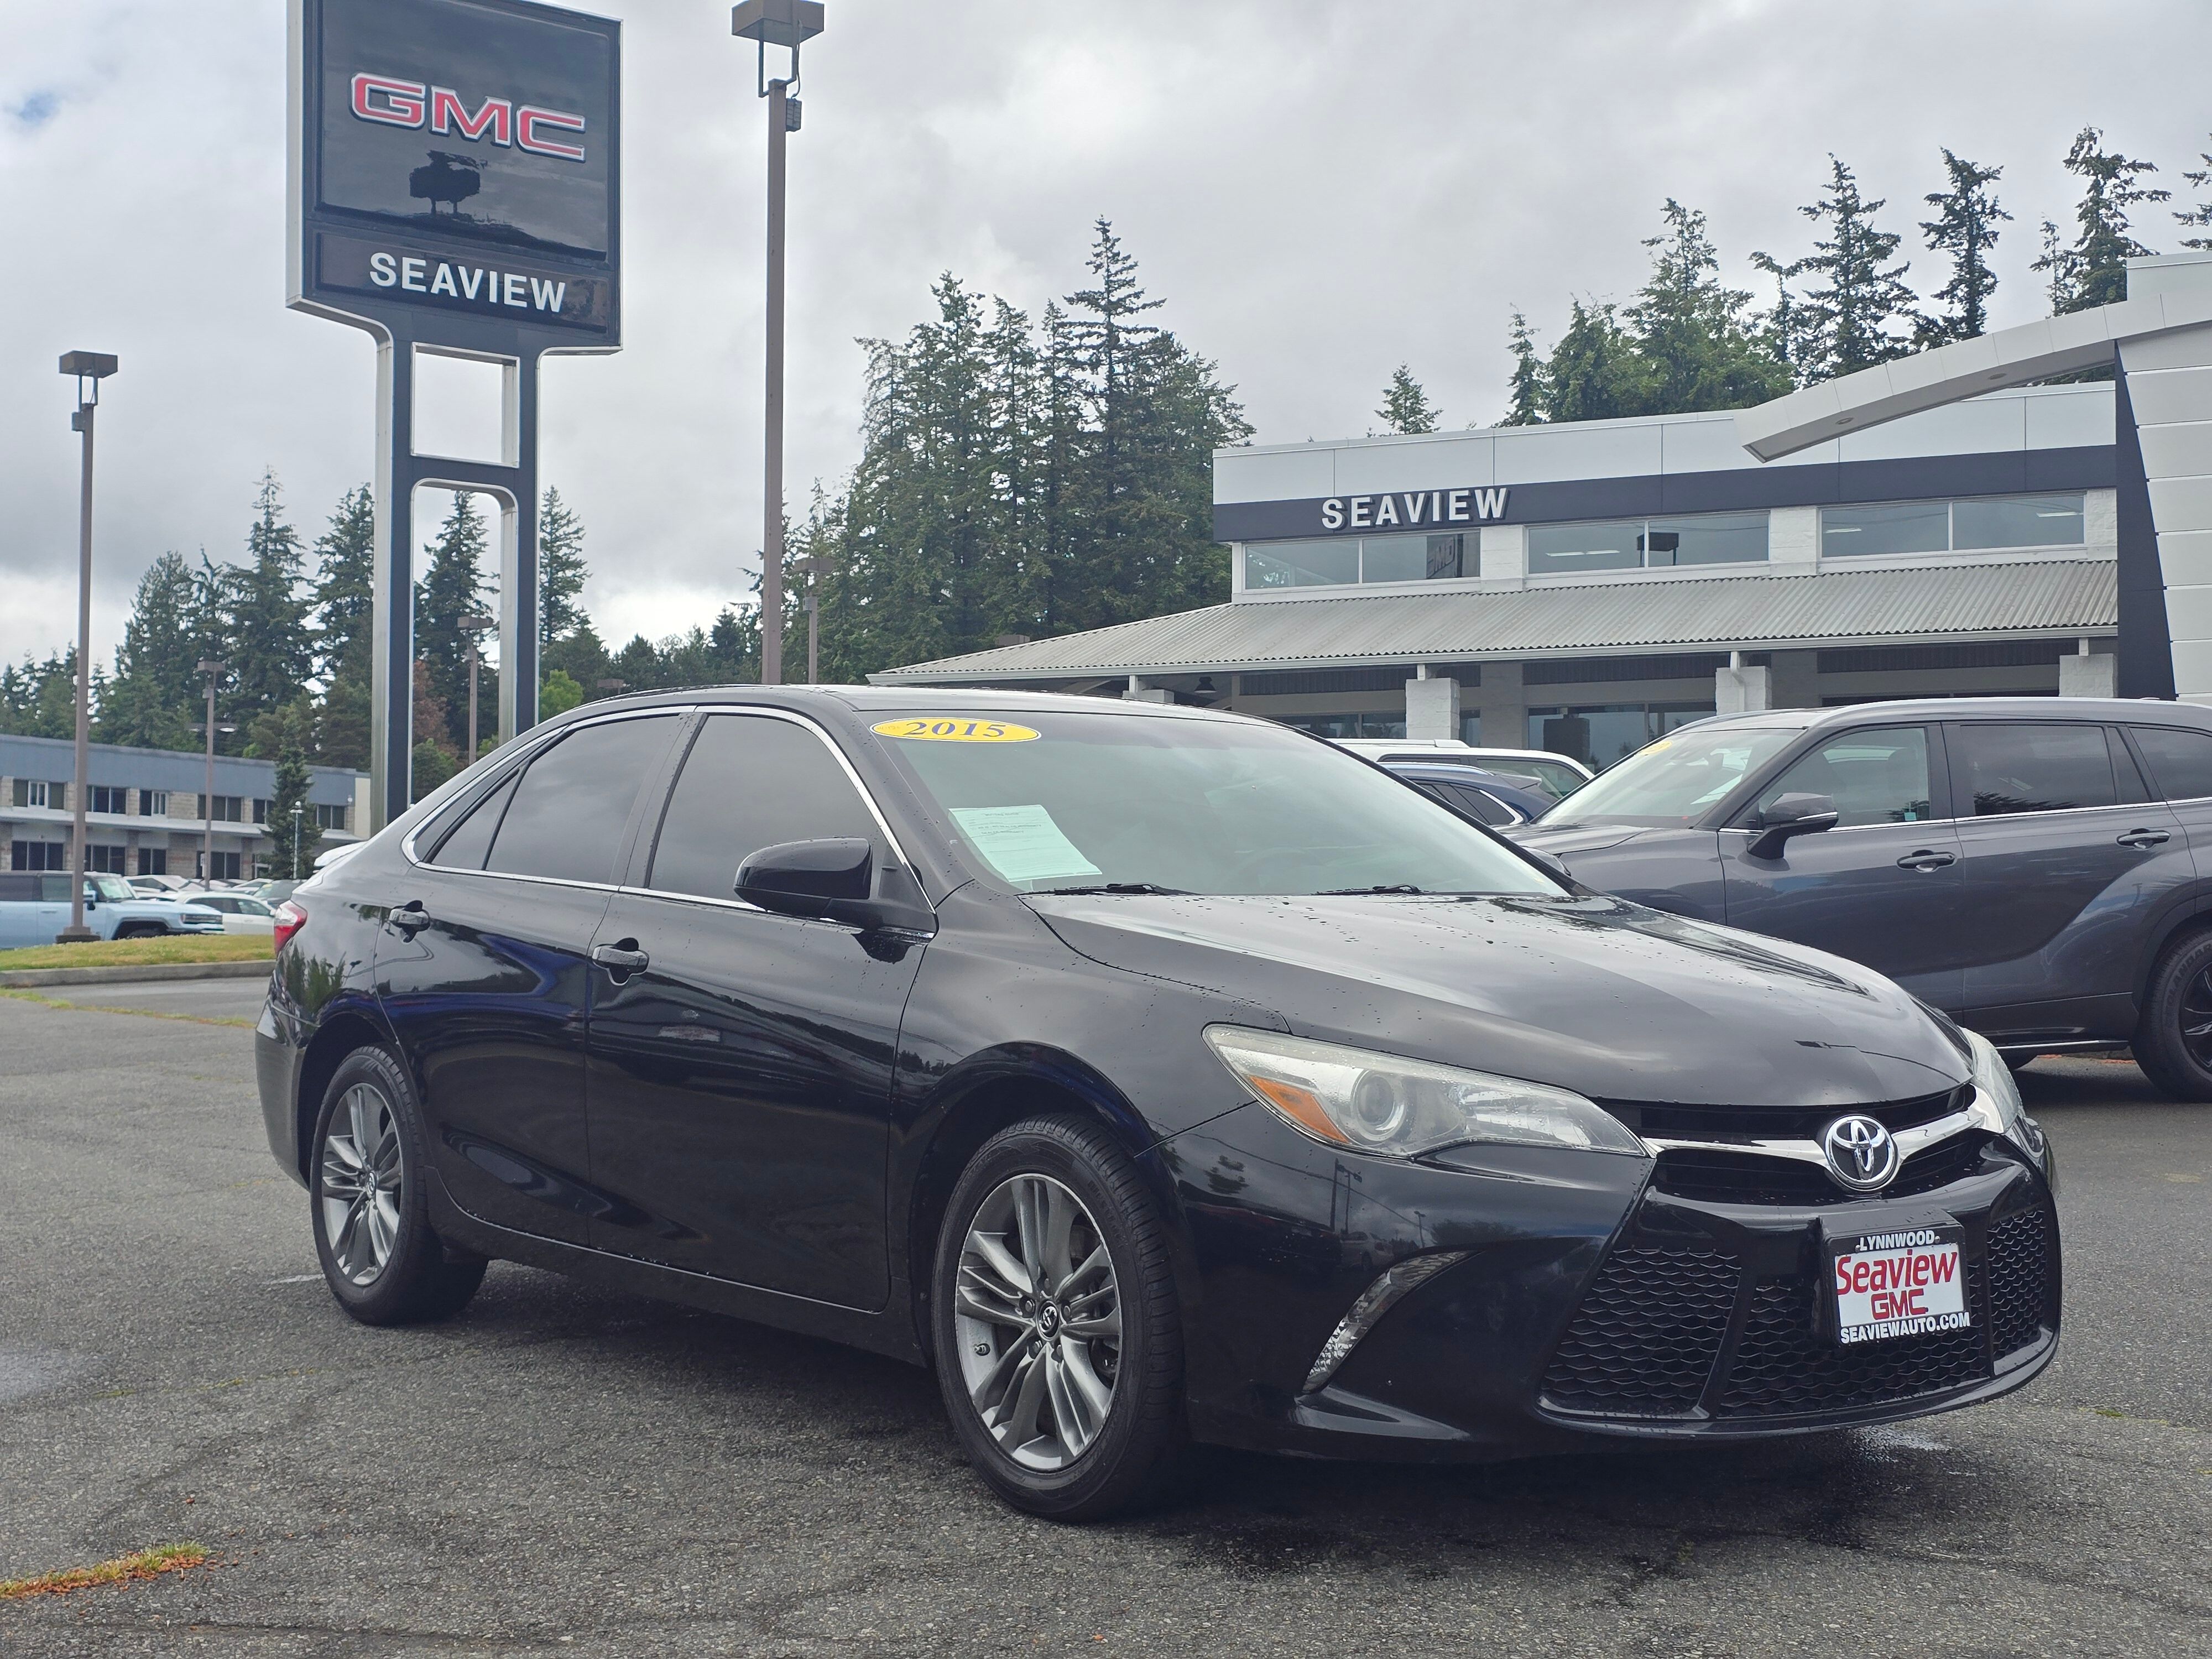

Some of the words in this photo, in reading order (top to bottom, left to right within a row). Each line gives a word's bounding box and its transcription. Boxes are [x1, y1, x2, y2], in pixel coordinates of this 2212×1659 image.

[351, 72, 586, 161] GMC
[369, 252, 566, 312] SEAVIEW
[1322, 488, 1508, 529] SEAVIEW
[902, 722, 1006, 737] 2015
[1859, 1230, 1935, 1251] LYNNWOOD
[1837, 1249, 1958, 1295] Seaview
[1871, 1288, 1928, 1320] GMC
[1840, 1312, 1970, 1344] SEAVIEWAUTO.COM
